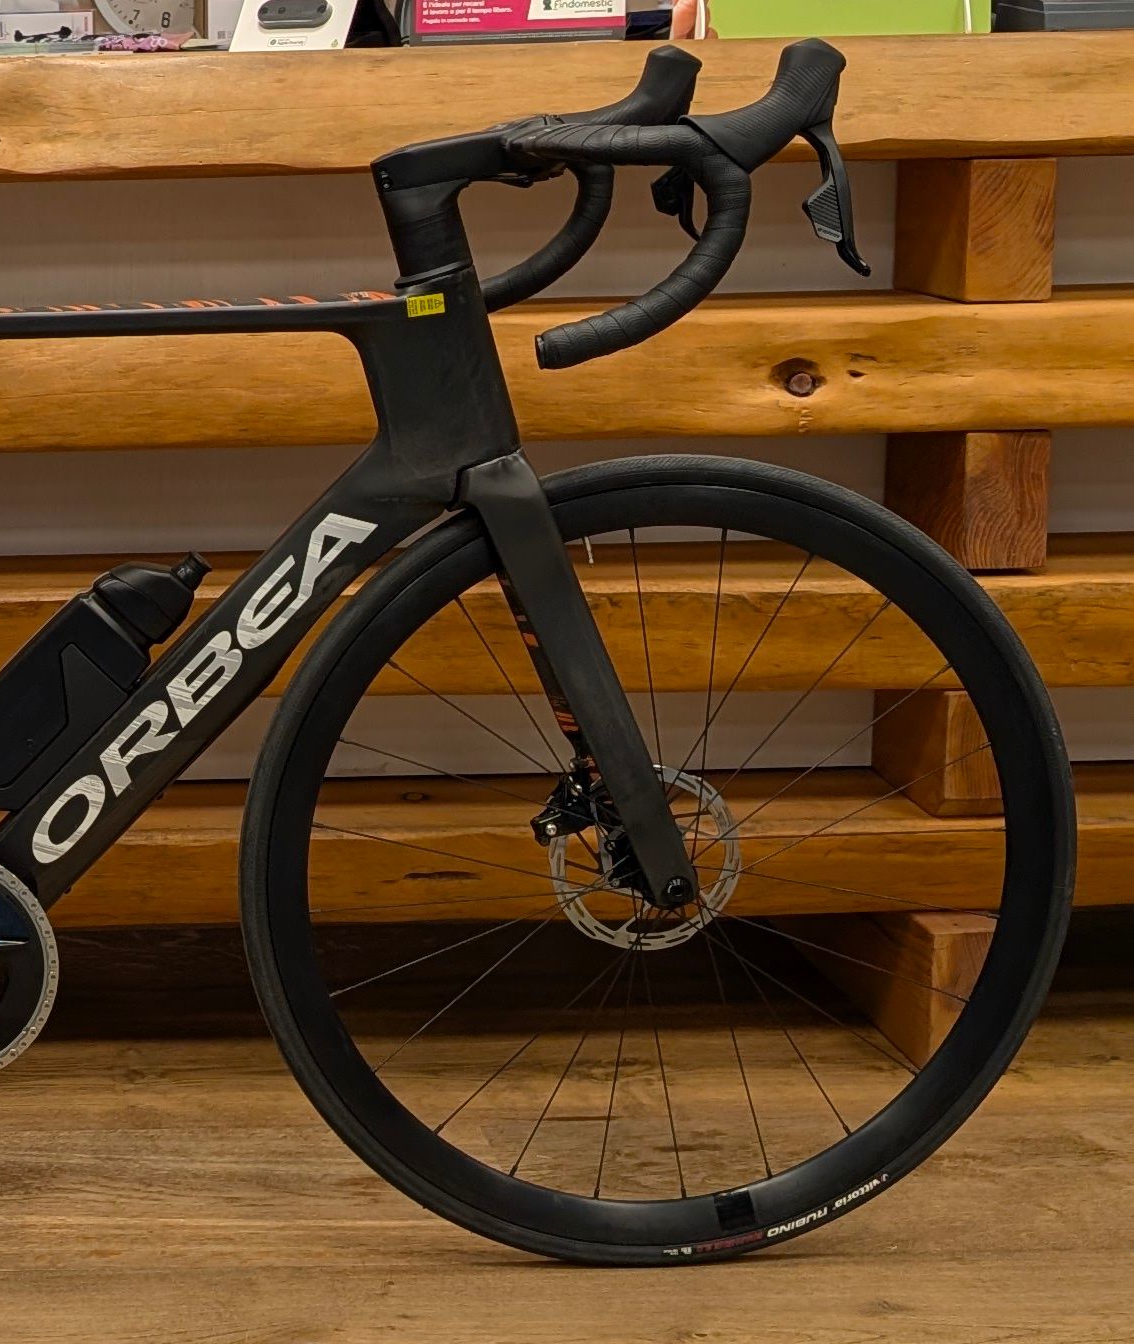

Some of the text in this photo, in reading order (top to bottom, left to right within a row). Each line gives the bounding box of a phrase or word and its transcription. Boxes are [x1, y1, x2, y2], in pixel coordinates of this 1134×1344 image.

[133, 9, 141, 22] 7
[161, 11, 171, 29] 6
[31, 512, 379, 864] ORBEA
[767, 1175, 881, 1238] vittoria RUBINO
